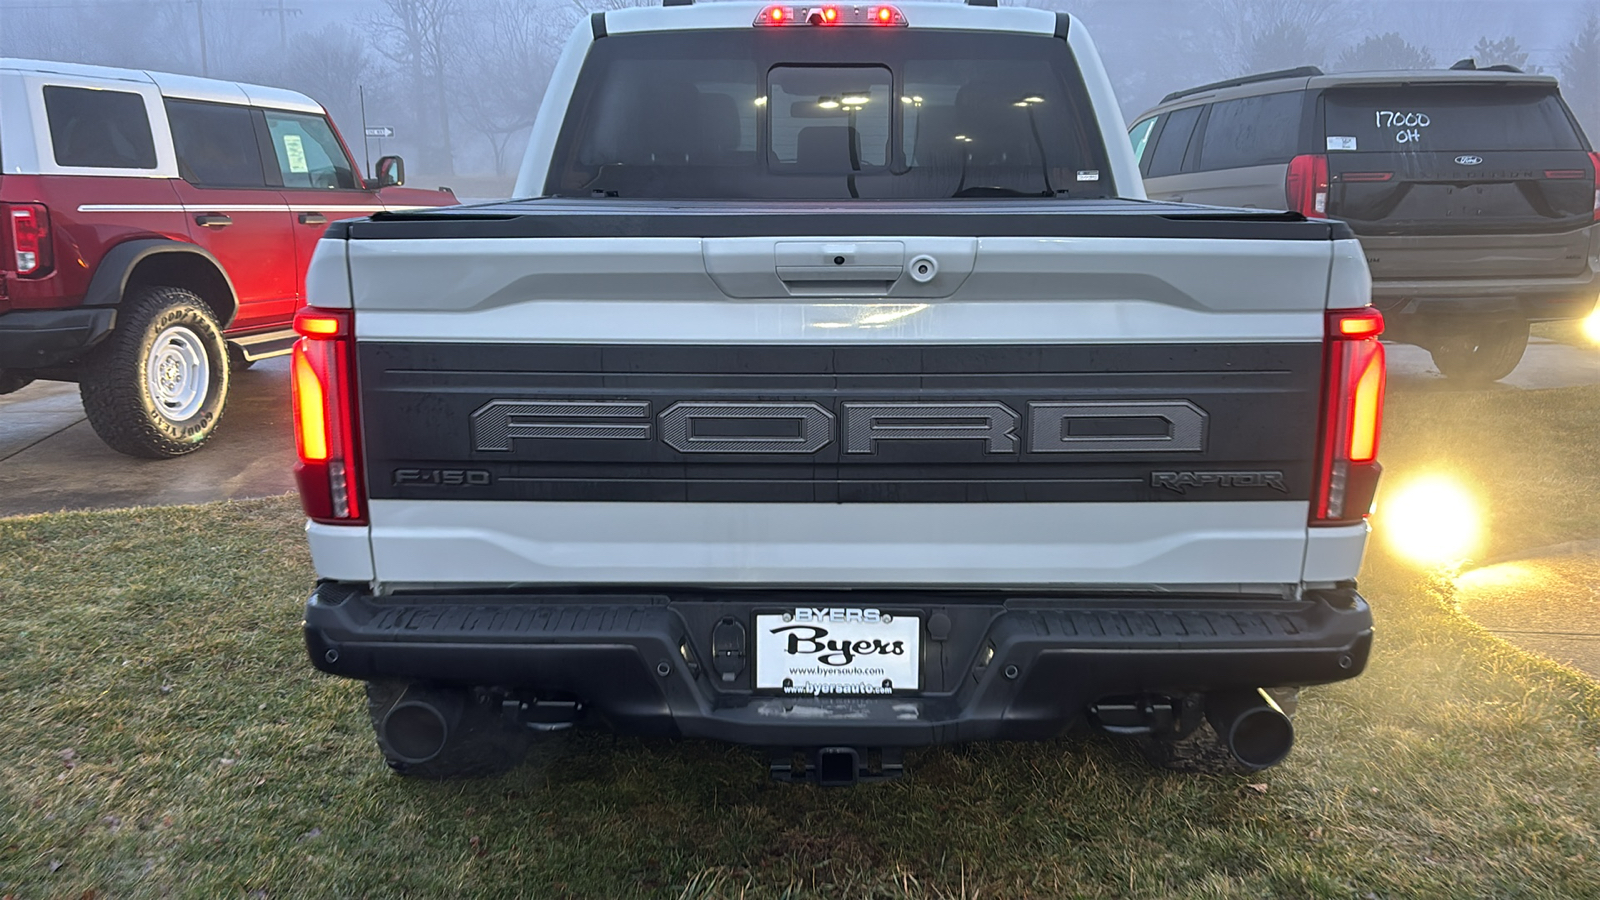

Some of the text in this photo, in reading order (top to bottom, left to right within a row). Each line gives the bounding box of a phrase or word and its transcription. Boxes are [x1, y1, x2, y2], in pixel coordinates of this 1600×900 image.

[1376, 111, 1430, 128] 17000
[1396, 129, 1420, 143] OH
[471, 399, 1208, 454] FORD
[393, 467, 491, 486] F-150
[1150, 471, 1288, 494] RAPTOR
[795, 607, 880, 623] BYERS
[769, 625, 904, 666] Byers
[789, 665, 884, 677] www.byersauto.com
[784, 681, 892, 696] www.byersauto.com
